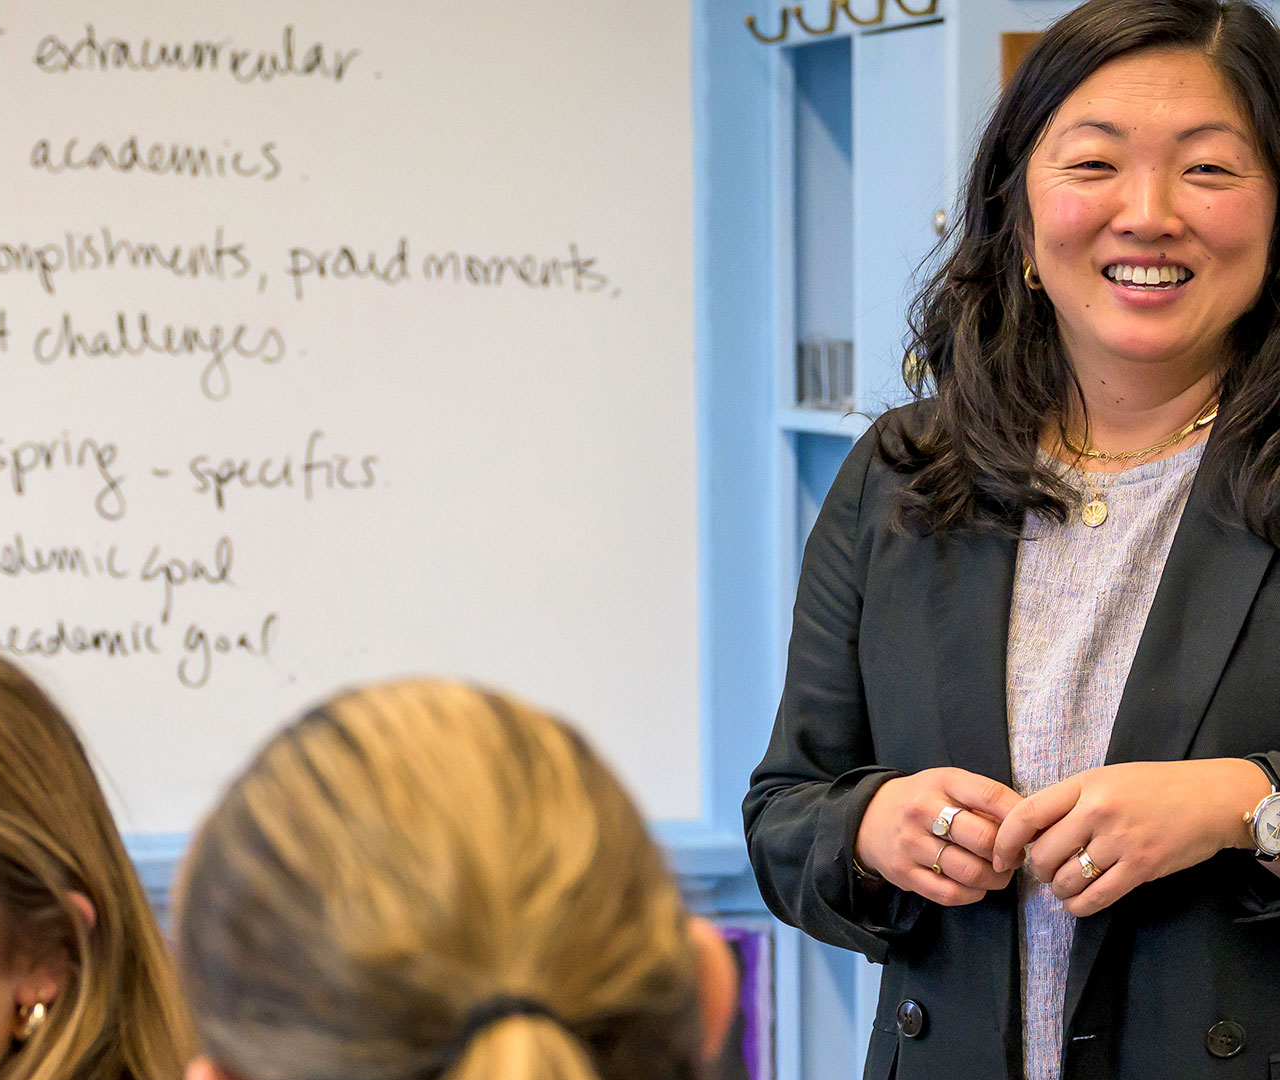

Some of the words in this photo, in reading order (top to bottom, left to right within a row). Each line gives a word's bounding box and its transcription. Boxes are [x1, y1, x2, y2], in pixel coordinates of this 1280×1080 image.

[284, 236, 411, 300] proud
[139, 535, 237, 627] goal
[176, 611, 280, 690] goal
